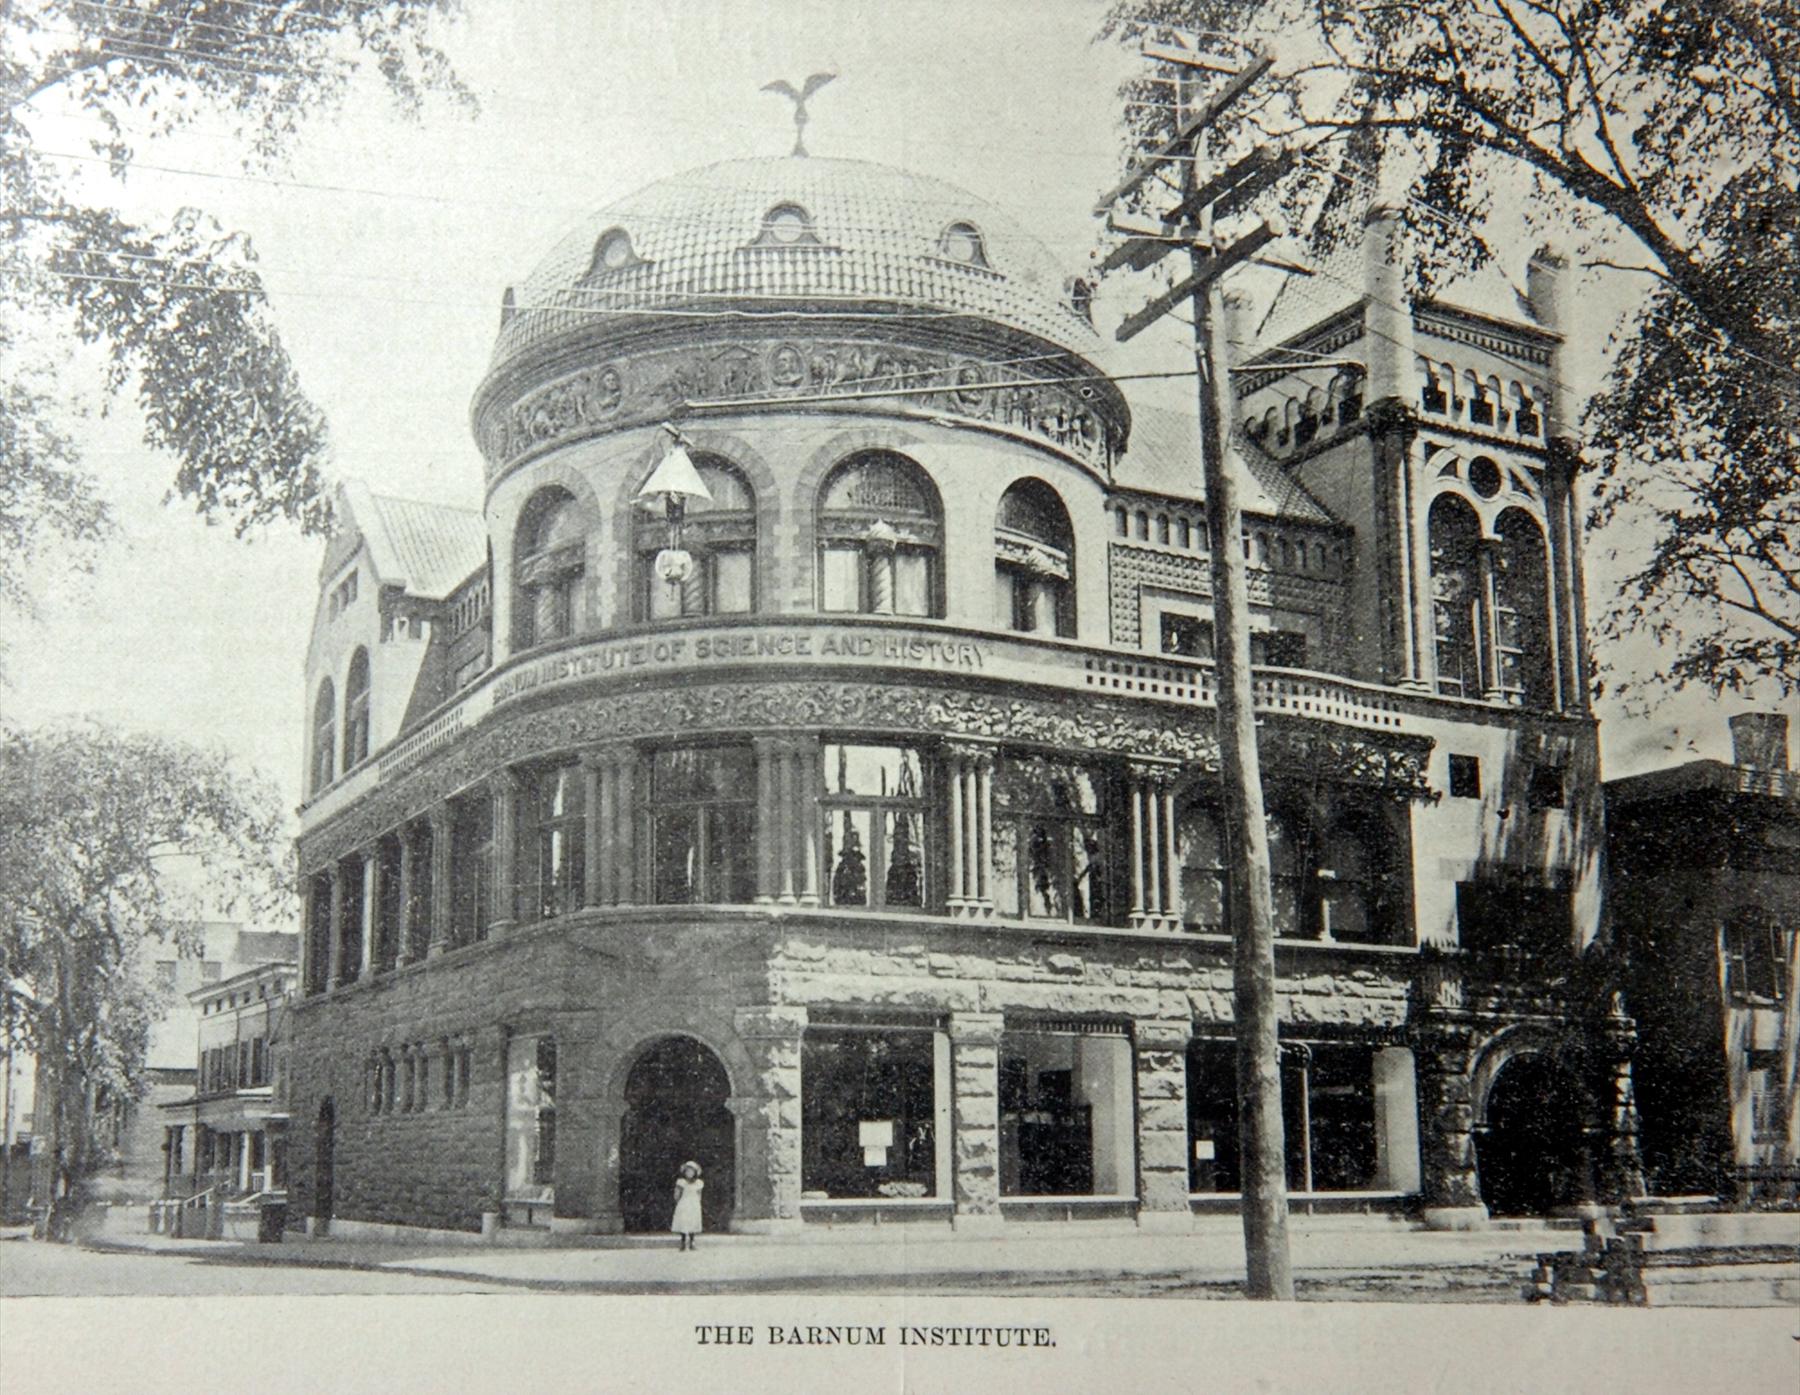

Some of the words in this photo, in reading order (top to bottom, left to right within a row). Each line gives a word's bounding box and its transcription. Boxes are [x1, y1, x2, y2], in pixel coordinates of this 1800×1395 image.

[541, 643, 648, 684] INSTITUTE
[654, 639, 686, 662] OF
[694, 635, 811, 659] SCIENCE
[820, 635, 874, 656] AND
[884, 637, 984, 668] HISTORY
